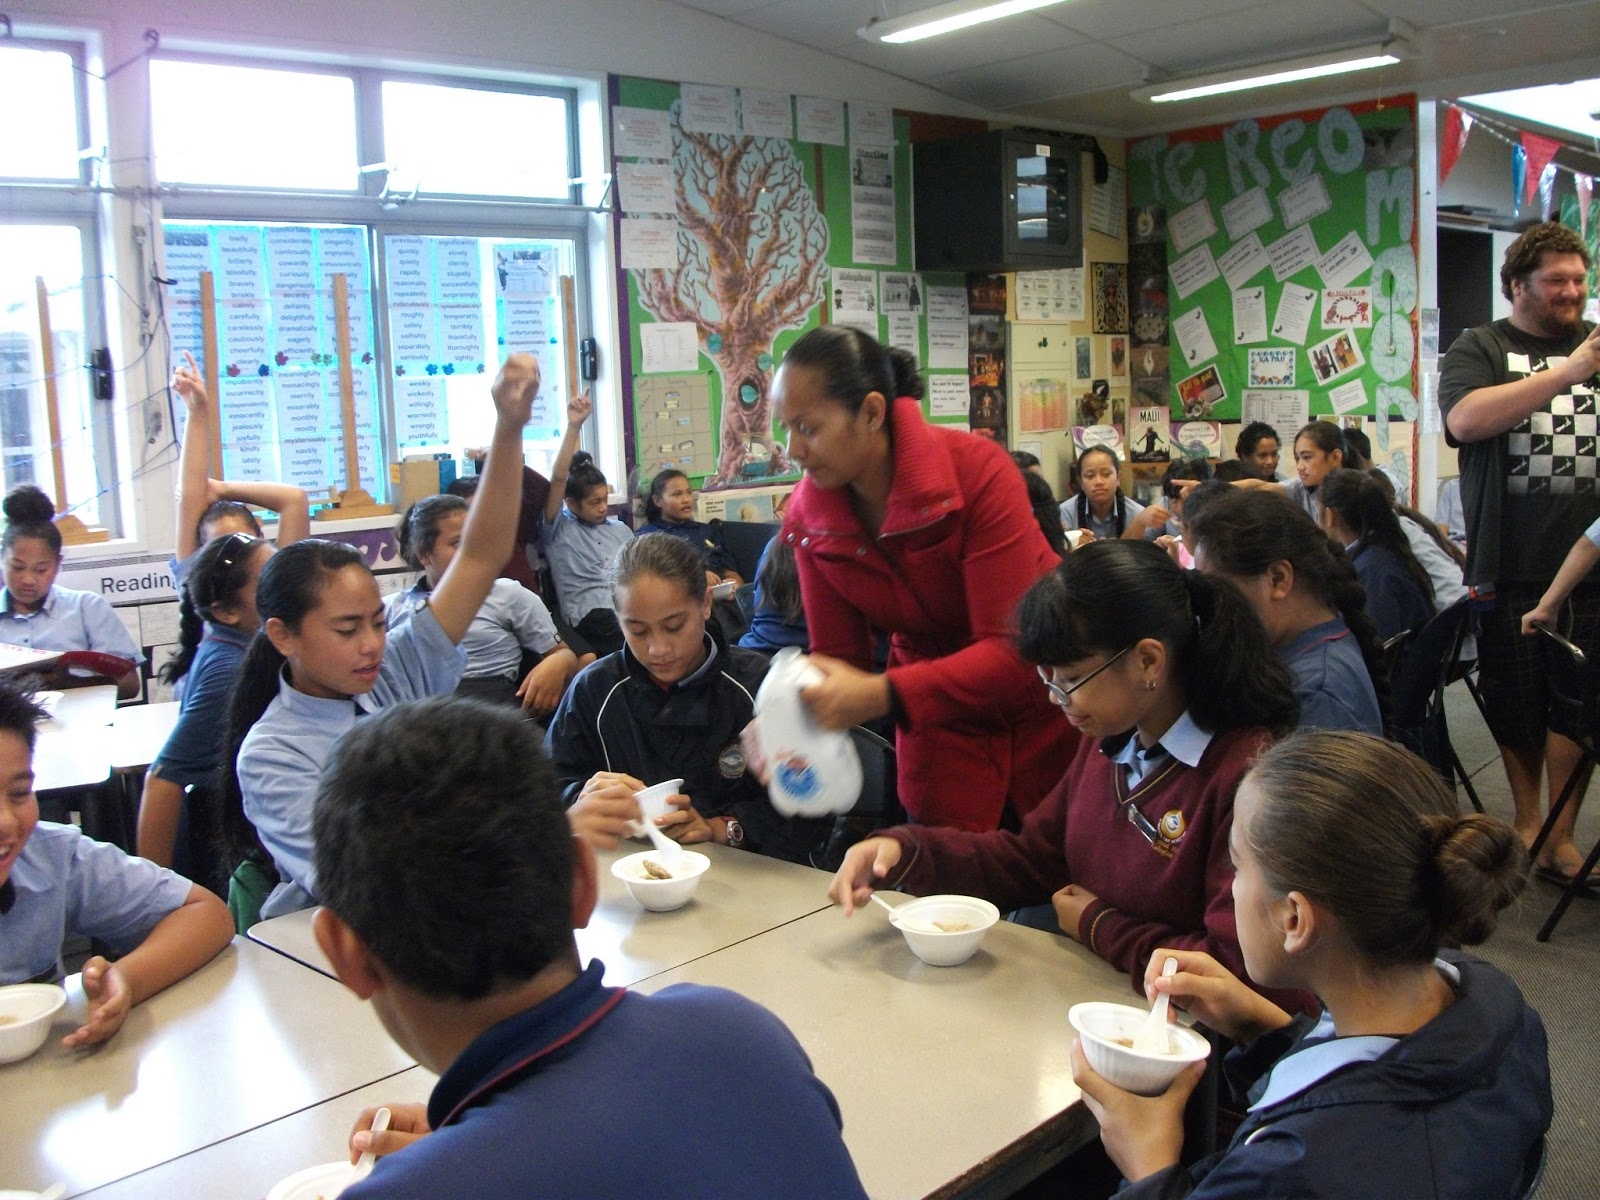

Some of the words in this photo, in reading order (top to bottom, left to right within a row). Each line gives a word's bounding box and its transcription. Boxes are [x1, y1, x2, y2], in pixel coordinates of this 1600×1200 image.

[324, 239, 354, 247] elegantly
[438, 238, 477, 247] significantly
[221, 246, 258, 254] beautifully
[274, 249, 311, 257] continually
[324, 250, 355, 258] enjoyably
[397, 248, 420, 256] quickly
[448, 249, 468, 257] slowly
[227, 258, 253, 266] bitterly
[278, 260, 309, 268] cowardly
[399, 258, 420, 266] quietly
[447, 259, 470, 267] sternly
[399, 269, 421, 277] rapidly
[446, 270, 472, 278] stupidly
[228, 280, 255, 288] bravely
[275, 282, 315, 290] dangerously
[393, 280, 427, 288] reasonably
[440, 281, 479, 289] successfully
[394, 290, 427, 298] repeatedly
[442, 291, 479, 299] surprisingly
[283, 303, 311, 311] defiantly
[280, 314, 315, 322] delightfully
[400, 311, 425, 319] roughly
[443, 312, 479, 320] temporarily
[226, 324, 264, 332] carelessly
[278, 325, 317, 333] dramatically
[403, 321, 423, 329] safely
[287, 336, 311, 344] eagerly
[400, 332, 427, 340] selfishly
[447, 333, 478, 341] thankfully
[283, 347, 315, 355] efficiently
[397, 343, 431, 351] separately
[447, 344, 480, 352] thoroughly
[400, 353, 430, 361] seriously
[236, 358, 260, 366] clearly
[278, 370, 321, 378] meaningfully
[224, 378, 264, 386] impatiently
[281, 381, 320, 389] menacingly
[409, 380, 432, 388] weekly
[225, 389, 265, 397] incorrectly
[290, 392, 315, 400] merrily
[407, 390, 435, 398] wickedly
[223, 400, 269, 409] independently
[286, 402, 320, 411] miserably
[408, 400, 435, 408] willingly
[228, 411, 265, 419] innocently
[290, 413, 318, 421] monthly
[407, 411, 437, 419] worriedly
[1139, 410, 1161, 423] MAUI
[232, 422, 264, 431] jealously
[294, 425, 317, 433] mostly
[410, 422, 436, 430] wrongly
[236, 434, 261, 442] joyfully
[284, 436, 326, 444] mysteriously
[407, 432, 439, 441] youthfully
[291, 457, 322, 466] naughtily
[291, 468, 324, 477] nervously
[298, 479, 319, 487] nicely
[100, 572, 177, 595] Readin
